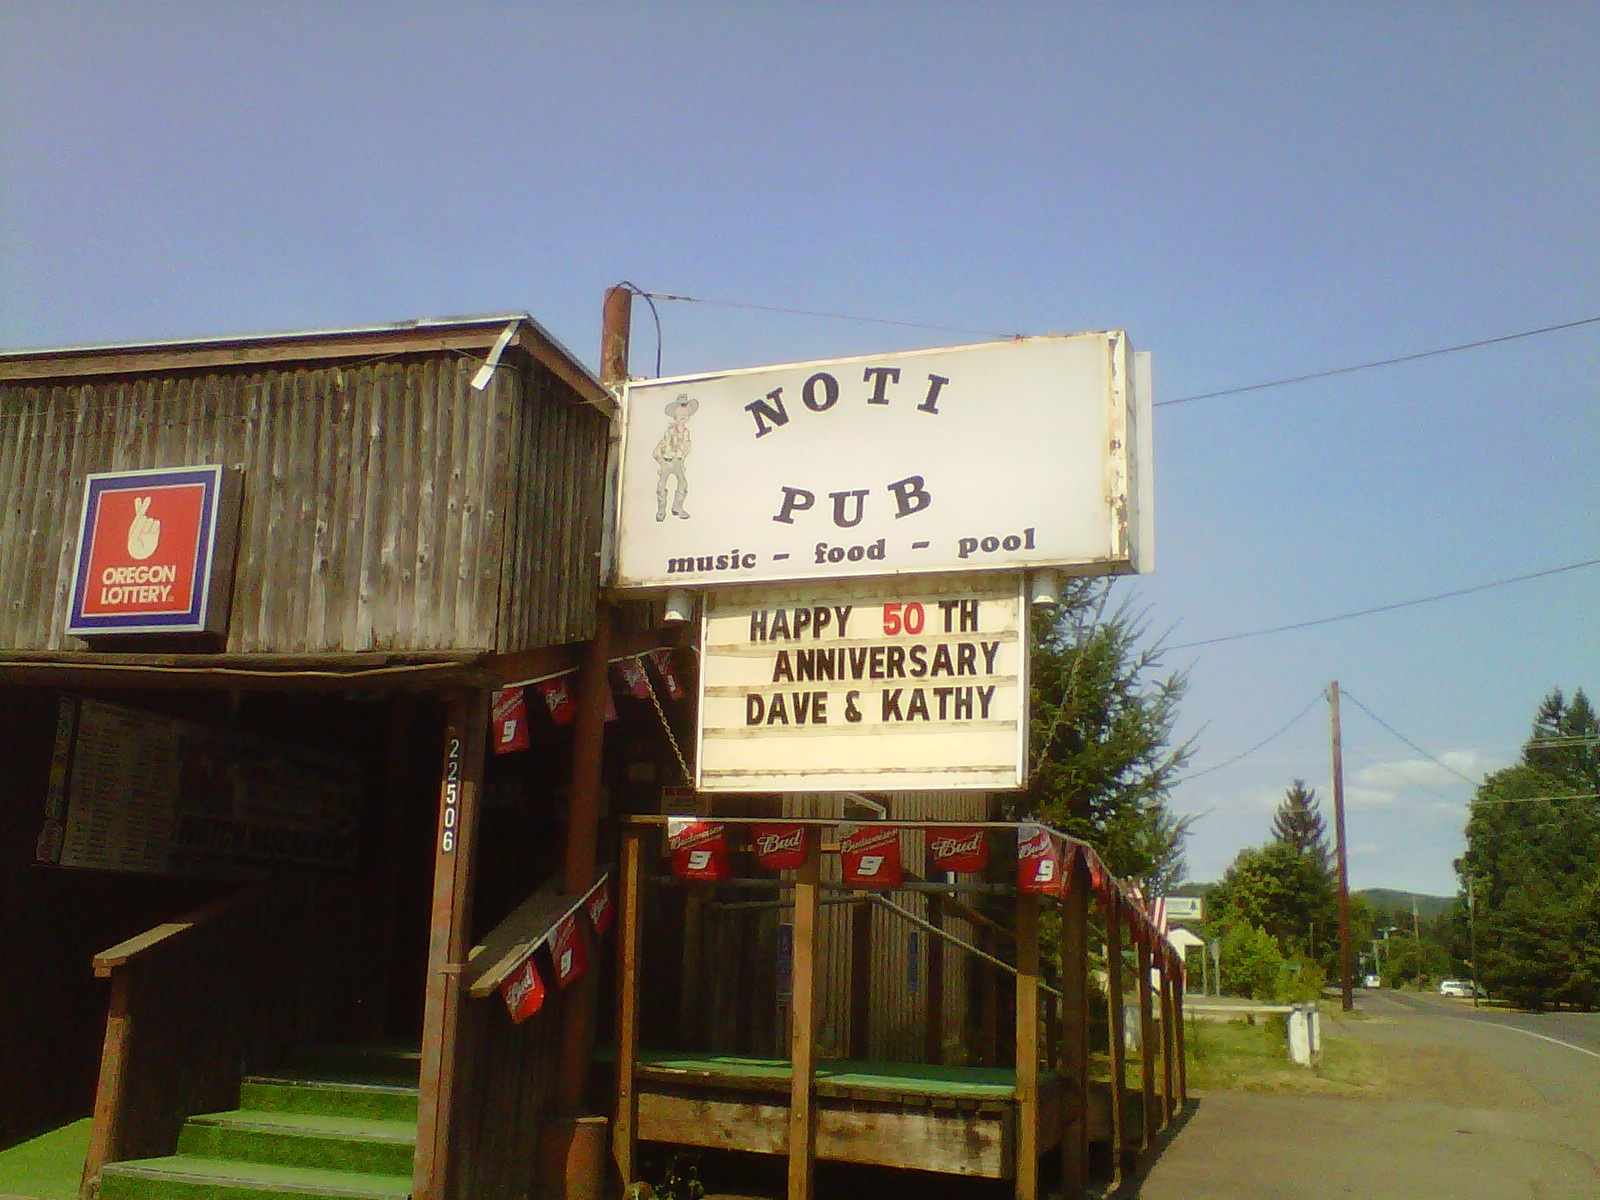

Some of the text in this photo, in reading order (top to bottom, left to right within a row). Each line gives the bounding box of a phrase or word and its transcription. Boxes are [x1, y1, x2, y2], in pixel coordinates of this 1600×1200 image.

[744, 367, 950, 439] NOTI
[773, 475, 932, 528] PUB
[667, 549, 757, 574] music
[814, 539, 886, 565] food
[958, 528, 1036, 559] pool
[102, 565, 176, 584] OREGON
[101, 585, 172, 605] LOTTERY
[750, 600, 979, 642] HAPPY 50 TH
[773, 640, 1000, 682] ANNIVERSARY
[745, 685, 997, 726] DAVE & KATHY
[502, 719, 517, 743] 9
[442, 738, 460, 852] 22506
[757, 828, 803, 855] Bud
[931, 830, 983, 858] Bud
[687, 851, 713, 869] 9
[857, 856, 885, 876] 9
[1035, 859, 1054, 882] 9
